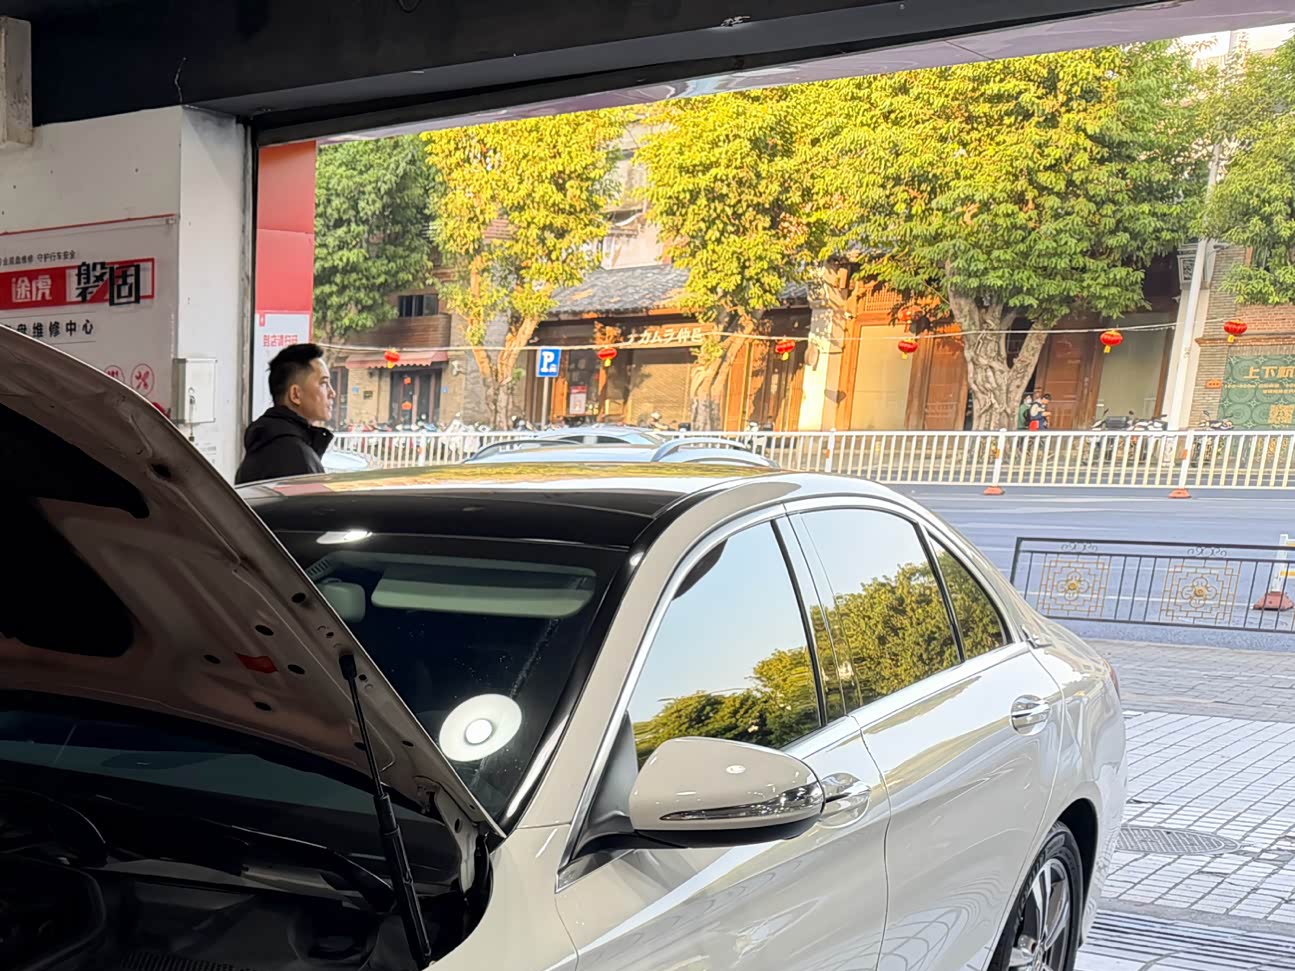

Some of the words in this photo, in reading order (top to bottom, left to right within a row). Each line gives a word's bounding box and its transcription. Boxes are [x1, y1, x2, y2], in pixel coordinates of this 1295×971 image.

[11, 274, 53, 303] 途虎
[5, 319, 94, 338] 盘维修中心
[540, 351, 555, 373] P
